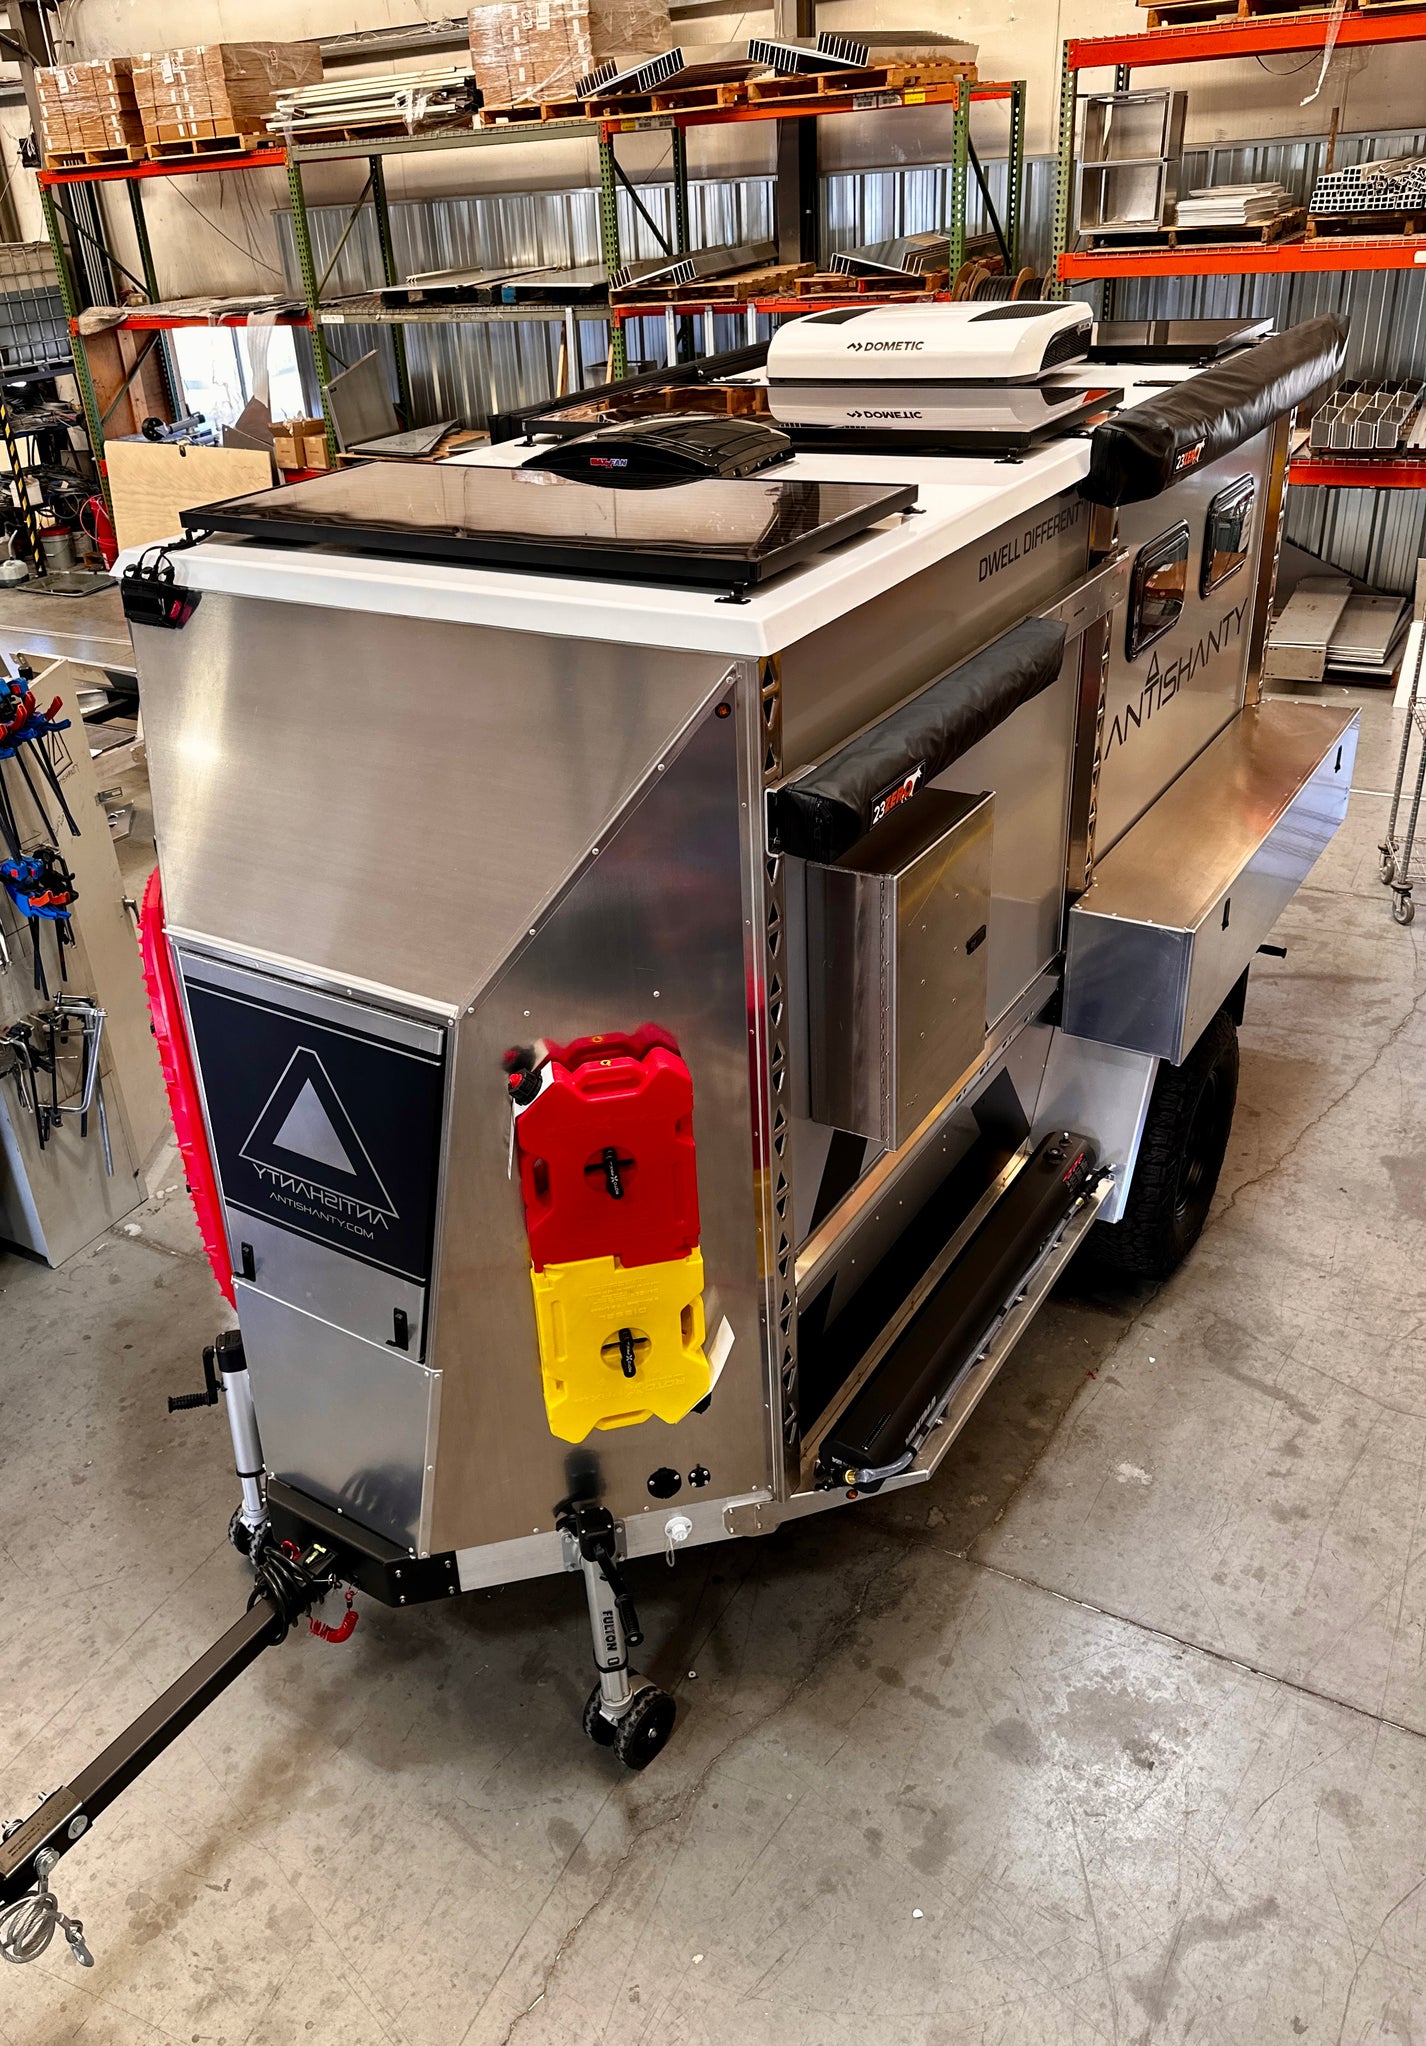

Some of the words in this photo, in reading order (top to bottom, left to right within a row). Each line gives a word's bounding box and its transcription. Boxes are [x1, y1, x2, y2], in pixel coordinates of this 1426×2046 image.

[863, 341, 925, 352] DOMETIC
[979, 537, 1021, 583] DWELL
[1023, 501, 1081, 555] DIFFERENT
[1104, 597, 1249, 761] ANTISHANTY
[269, 1191, 375, 1241] ANTISHANTY.COM
[602, 1610, 618, 1651] FULTON
